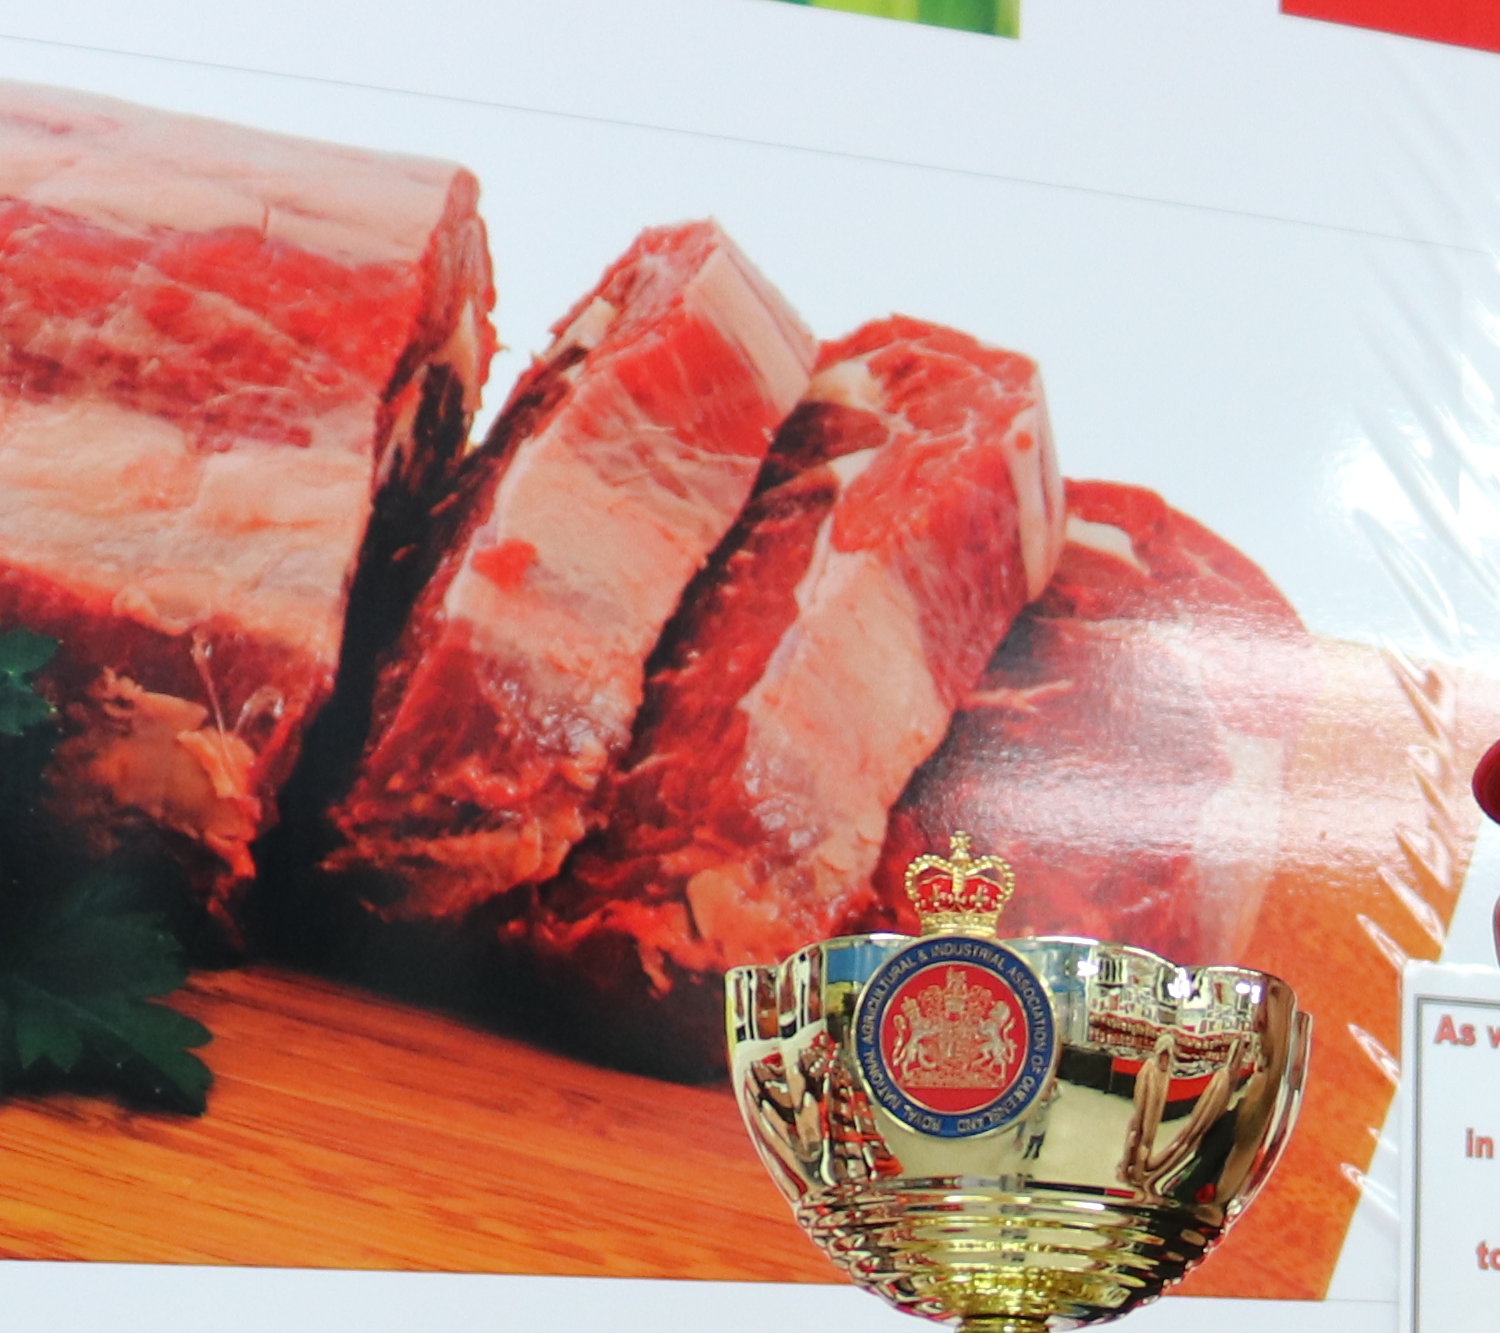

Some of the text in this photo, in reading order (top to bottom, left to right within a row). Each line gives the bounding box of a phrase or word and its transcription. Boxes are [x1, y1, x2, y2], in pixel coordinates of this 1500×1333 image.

[931, 943, 1005, 970] INDUSTRIAL
[862, 957, 914, 1044] AGRICULTURAL
[1007, 966, 1047, 1053] ASSOCIATION
[1434, 1014, 1476, 1045] As
[863, 1052, 900, 1109] NATIONAL
[1031, 1055, 1044, 1074] OF
[904, 1105, 942, 1132] ROYAL
[957, 1075, 1035, 1132] QUEENSLAND
